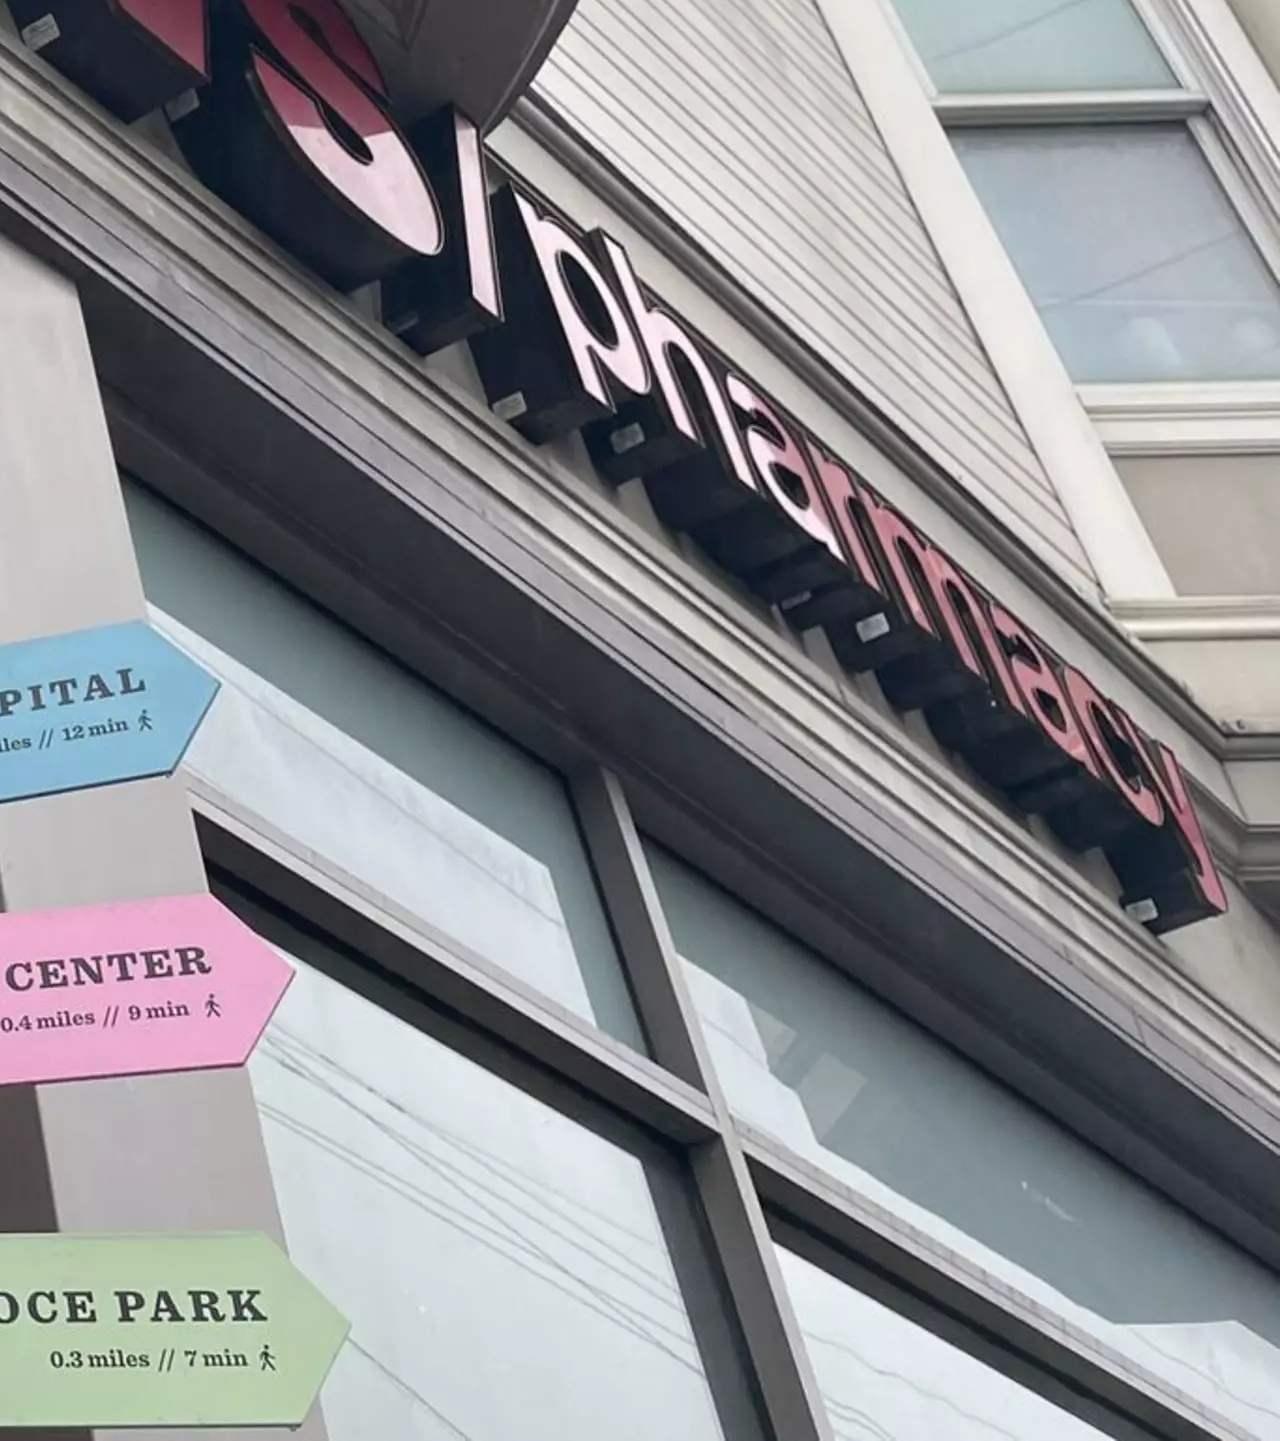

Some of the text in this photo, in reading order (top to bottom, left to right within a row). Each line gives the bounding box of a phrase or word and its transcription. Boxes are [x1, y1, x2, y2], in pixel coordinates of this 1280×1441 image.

[62, 726, 85, 742] 12
[88, 718, 129, 737] min
[5, 946, 212, 992] CENTER
[0, 1015, 32, 1033] 0.4
[37, 1010, 96, 1030] miles
[128, 1005, 141, 1021] 9
[145, 1001, 190, 1019] min
[114, 1289, 269, 1323] PARK
[50, 1350, 84, 1369] 0.3
[88, 1349, 150, 1368] miles
[184, 1350, 197, 1367] 7
[202, 1349, 249, 1367] min
